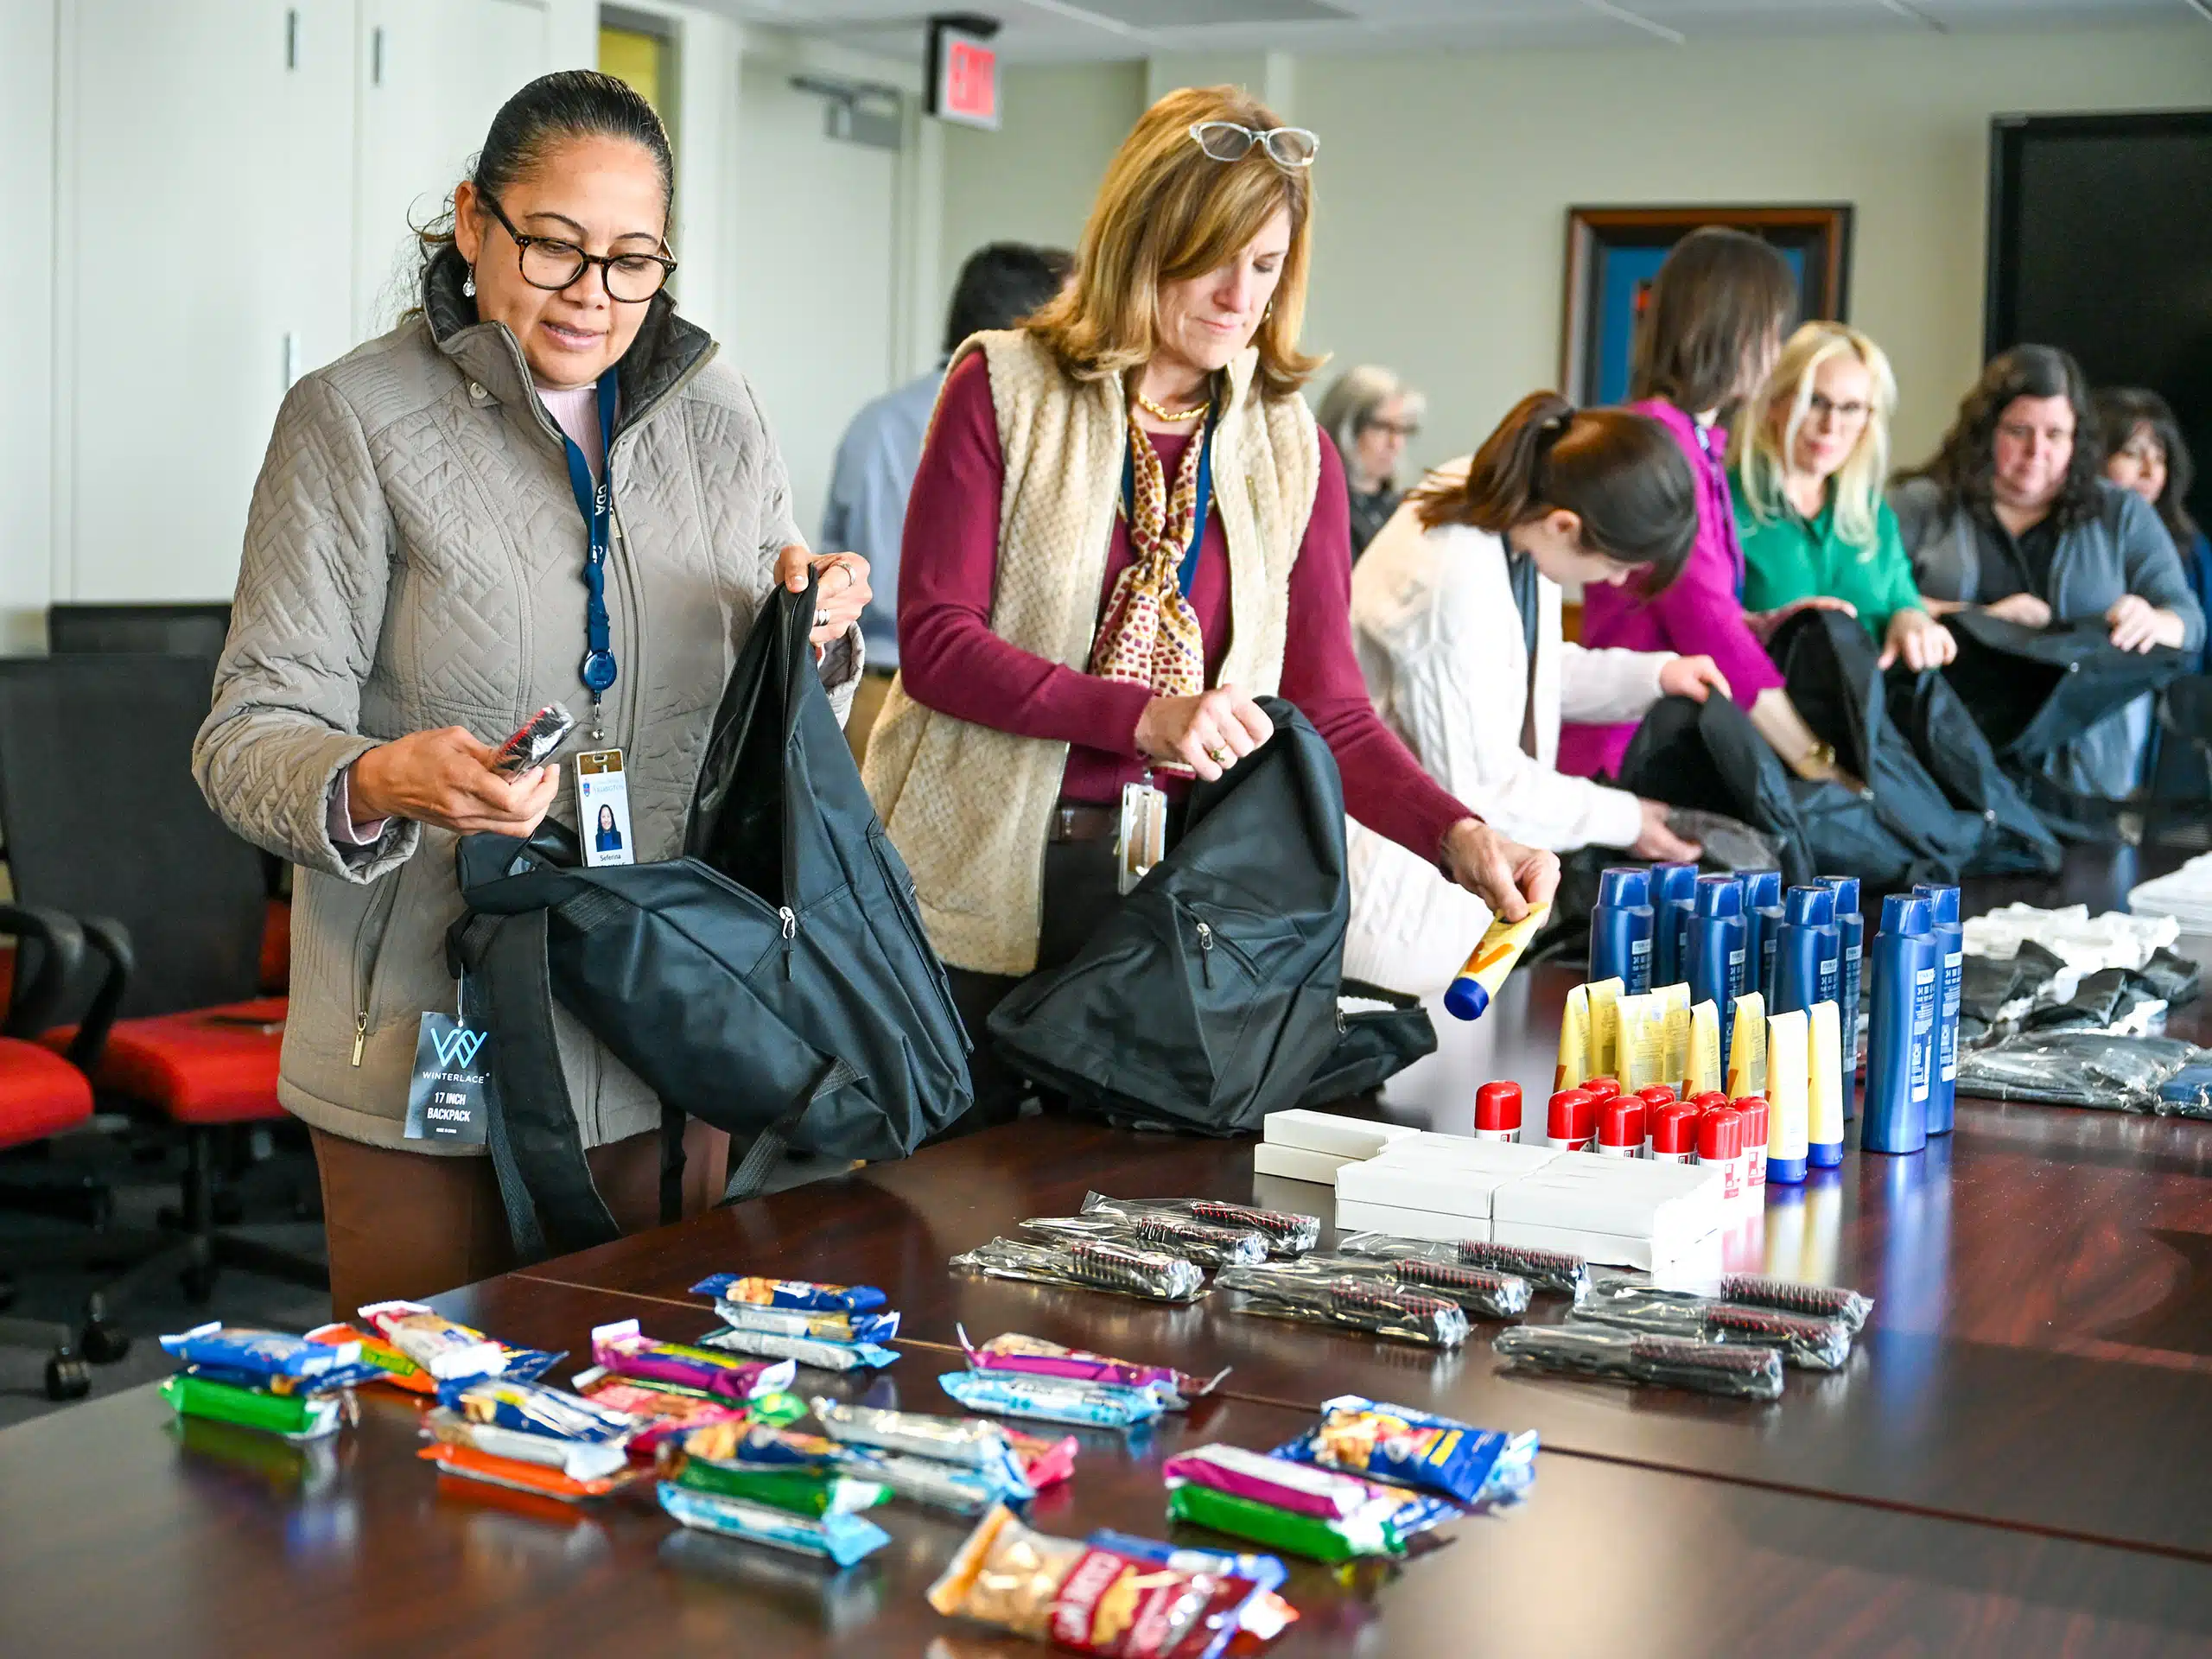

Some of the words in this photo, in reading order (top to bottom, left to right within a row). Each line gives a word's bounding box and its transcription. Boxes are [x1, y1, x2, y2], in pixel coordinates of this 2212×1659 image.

[594, 484, 607, 516] CDA
[422, 1071, 485, 1084] WINTERLACE
[435, 1091, 445, 1104] 17
[446, 1093, 467, 1106] INCH
[427, 1107, 472, 1122] BACKPACK
